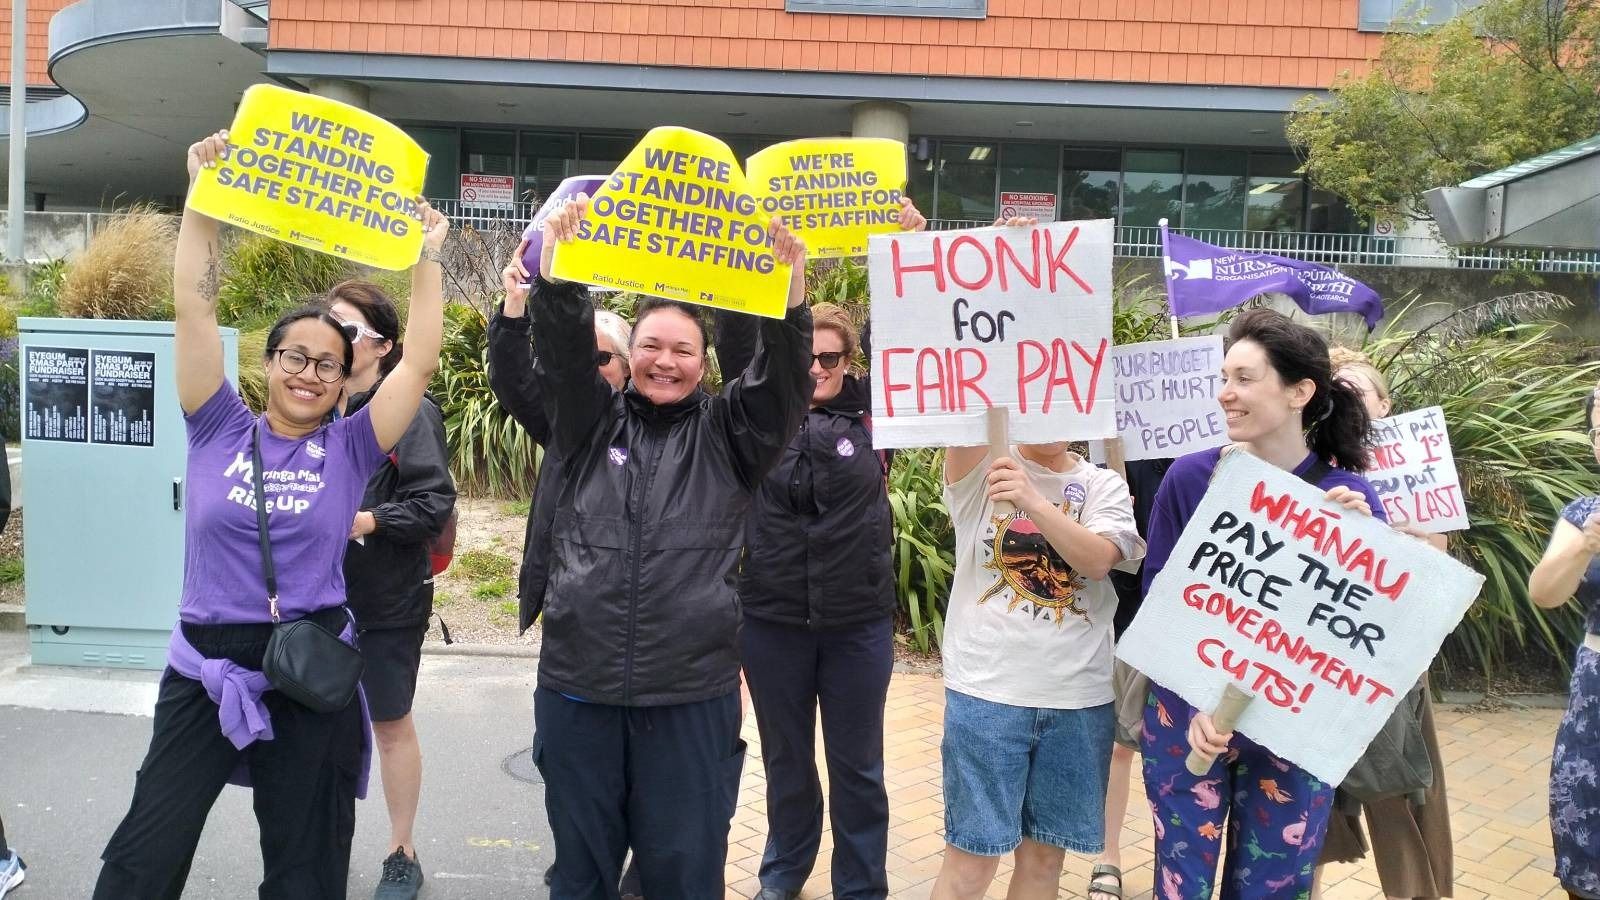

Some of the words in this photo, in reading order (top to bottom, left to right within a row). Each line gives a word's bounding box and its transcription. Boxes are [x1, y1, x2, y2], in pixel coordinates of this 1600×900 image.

[291, 111, 375, 154] WE'RE
[253, 127, 395, 184] STANDING
[645, 147, 731, 184] WE'RE
[789, 153, 855, 171] WE'RE
[223, 143, 363, 200] TOGETHER
[366, 184, 417, 217] FOR
[609, 171, 756, 216] STANDING
[769, 171, 878, 192] STANDING
[217, 167, 283, 200] SAFE
[285, 186, 409, 237] STAFFING
[861, 189, 902, 206] FOR
[250, 219, 281, 236] Justice
[593, 196, 721, 240] OGETHER
[782, 214, 803, 231] FE
[805, 208, 900, 229] STAFFING
[577, 220, 643, 251] SAFE
[647, 232, 775, 275] STAFFING
[891, 226, 1093, 297] HONK
[1214, 255, 1236, 265] NEW
[592, 273, 614, 284] Ratio
[615, 275, 645, 289] Justice
[1215, 267, 1288, 281] ORGANISATION
[953, 298, 1015, 343] for
[29, 351, 66, 360] EYEGUM
[29, 359, 55, 368] XMAS
[56, 360, 86, 369] PARTY
[29, 366, 84, 376] FUNDRAISER
[95, 354, 132, 364] EYEGUM
[95, 362, 120, 371] XMAS
[122, 363, 152, 372] PARTY
[1150, 347, 1215, 377] BUDGET
[95, 370, 150, 379] FUNDRAISER
[882, 347, 994, 417] FAIR
[1017, 337, 1108, 414] PAY
[1115, 379, 1155, 404] UTS
[1161, 374, 1218, 401] HURT
[1115, 409, 1151, 431] EAL
[1141, 411, 1223, 451] PEOPLE
[1409, 410, 1438, 442] put
[298, 469, 321, 483] Mai
[1369, 477, 1400, 495] ou
[1404, 464, 1437, 495] put
[1382, 496, 1410, 523] ES
[1414, 484, 1460, 523] LAST
[1248, 480, 1416, 601] WHĀNAU
[1209, 511, 1285, 562] PAY
[1297, 553, 1373, 612] THE
[1187, 540, 1293, 612] PRICE
[1307, 603, 1386, 657] FOR
[1182, 583, 1395, 705] GOVERNMENT
[1197, 638, 1316, 714] CUTS!
